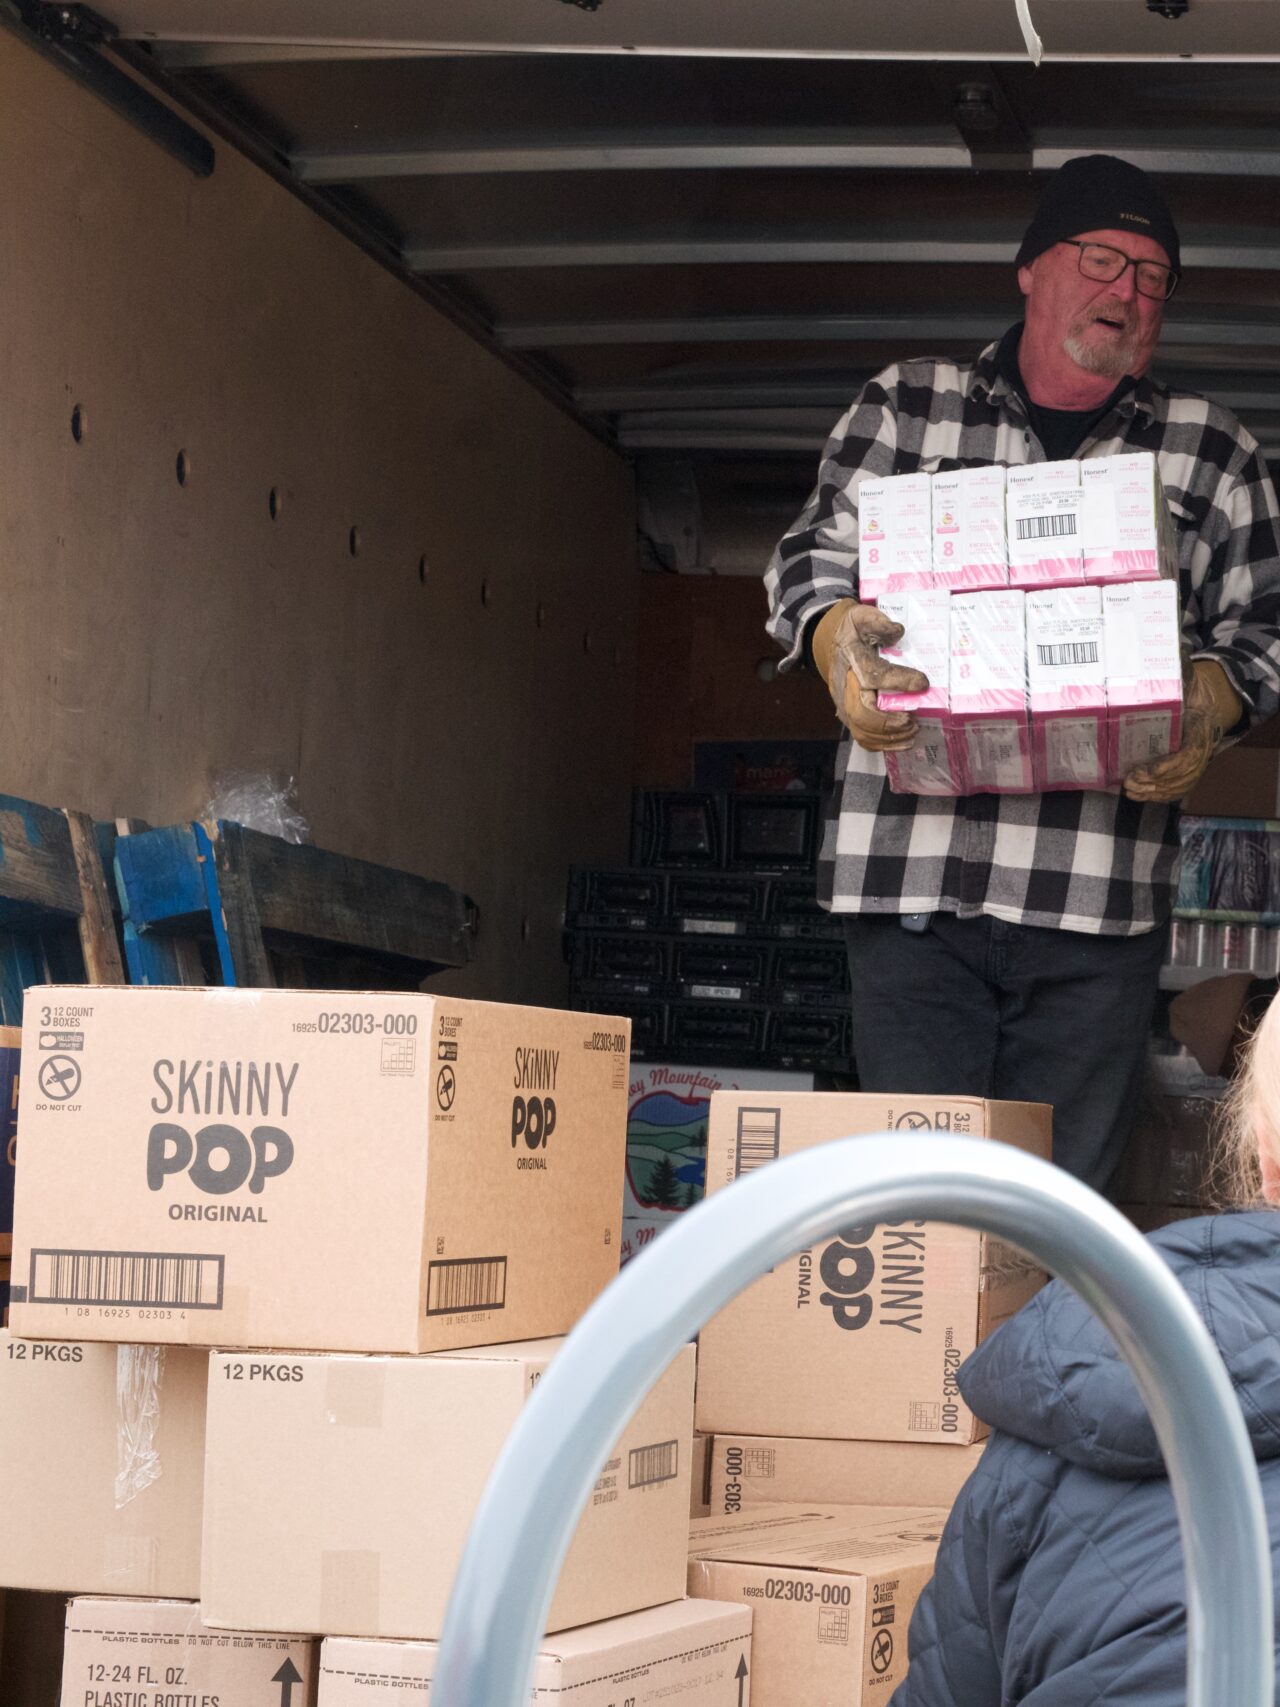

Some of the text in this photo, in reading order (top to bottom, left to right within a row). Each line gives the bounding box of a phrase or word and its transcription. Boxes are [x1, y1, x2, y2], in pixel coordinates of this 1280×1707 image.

[868, 548, 880, 564] 8
[943, 541, 954, 557] 8
[959, 663, 971, 679] 8
[41, 1006, 94, 1027] 3 12 COUNT
[53, 1018, 81, 1027] BOXES
[292, 1012, 418, 1036] 16925 02303-000
[439, 1016, 445, 1036] 3
[592, 1032, 626, 1053] 02303-000
[649, 1067, 722, 1091] Mountain
[67, 1104, 82, 1112] CUT
[954, 1113, 970, 1122] 3
[511, 1095, 557, 1150] POP
[147, 1122, 295, 1196] POP
[517, 1158, 547, 1170] ORIGINAL
[168, 1204, 268, 1224] ORIGINAL
[798, 1249, 813, 1309] IGINAL
[99, 1308, 131, 1318] 16925
[138, 1309, 172, 1320] 02303
[180, 1310, 186, 1320] 4
[7, 1344, 83, 1363] 12 PKGS
[223, 1363, 304, 1383] 12 PKGS
[941, 1326, 961, 1433] 16925 02303-000
[725, 1447, 743, 1514] 303-000
[742, 1578, 851, 1606] 16925 02303-000
[873, 1584, 880, 1604] 3
[886, 1580, 900, 1592] COUNT
[102, 1635, 139, 1643] PLASTIC
[141, 1637, 180, 1645] BOTTLES
[188, 1638, 197, 1646] DO
[233, 1640, 254, 1648] BELOW
[258, 1641, 272, 1649] THIS
[275, 1642, 290, 1650] LINE
[87, 1664, 188, 1686] 12-24 FL. OZ.
[354, 1678, 429, 1690] PLASTIC BOTTLES
[85, 1690, 152, 1707] PLASTIC
